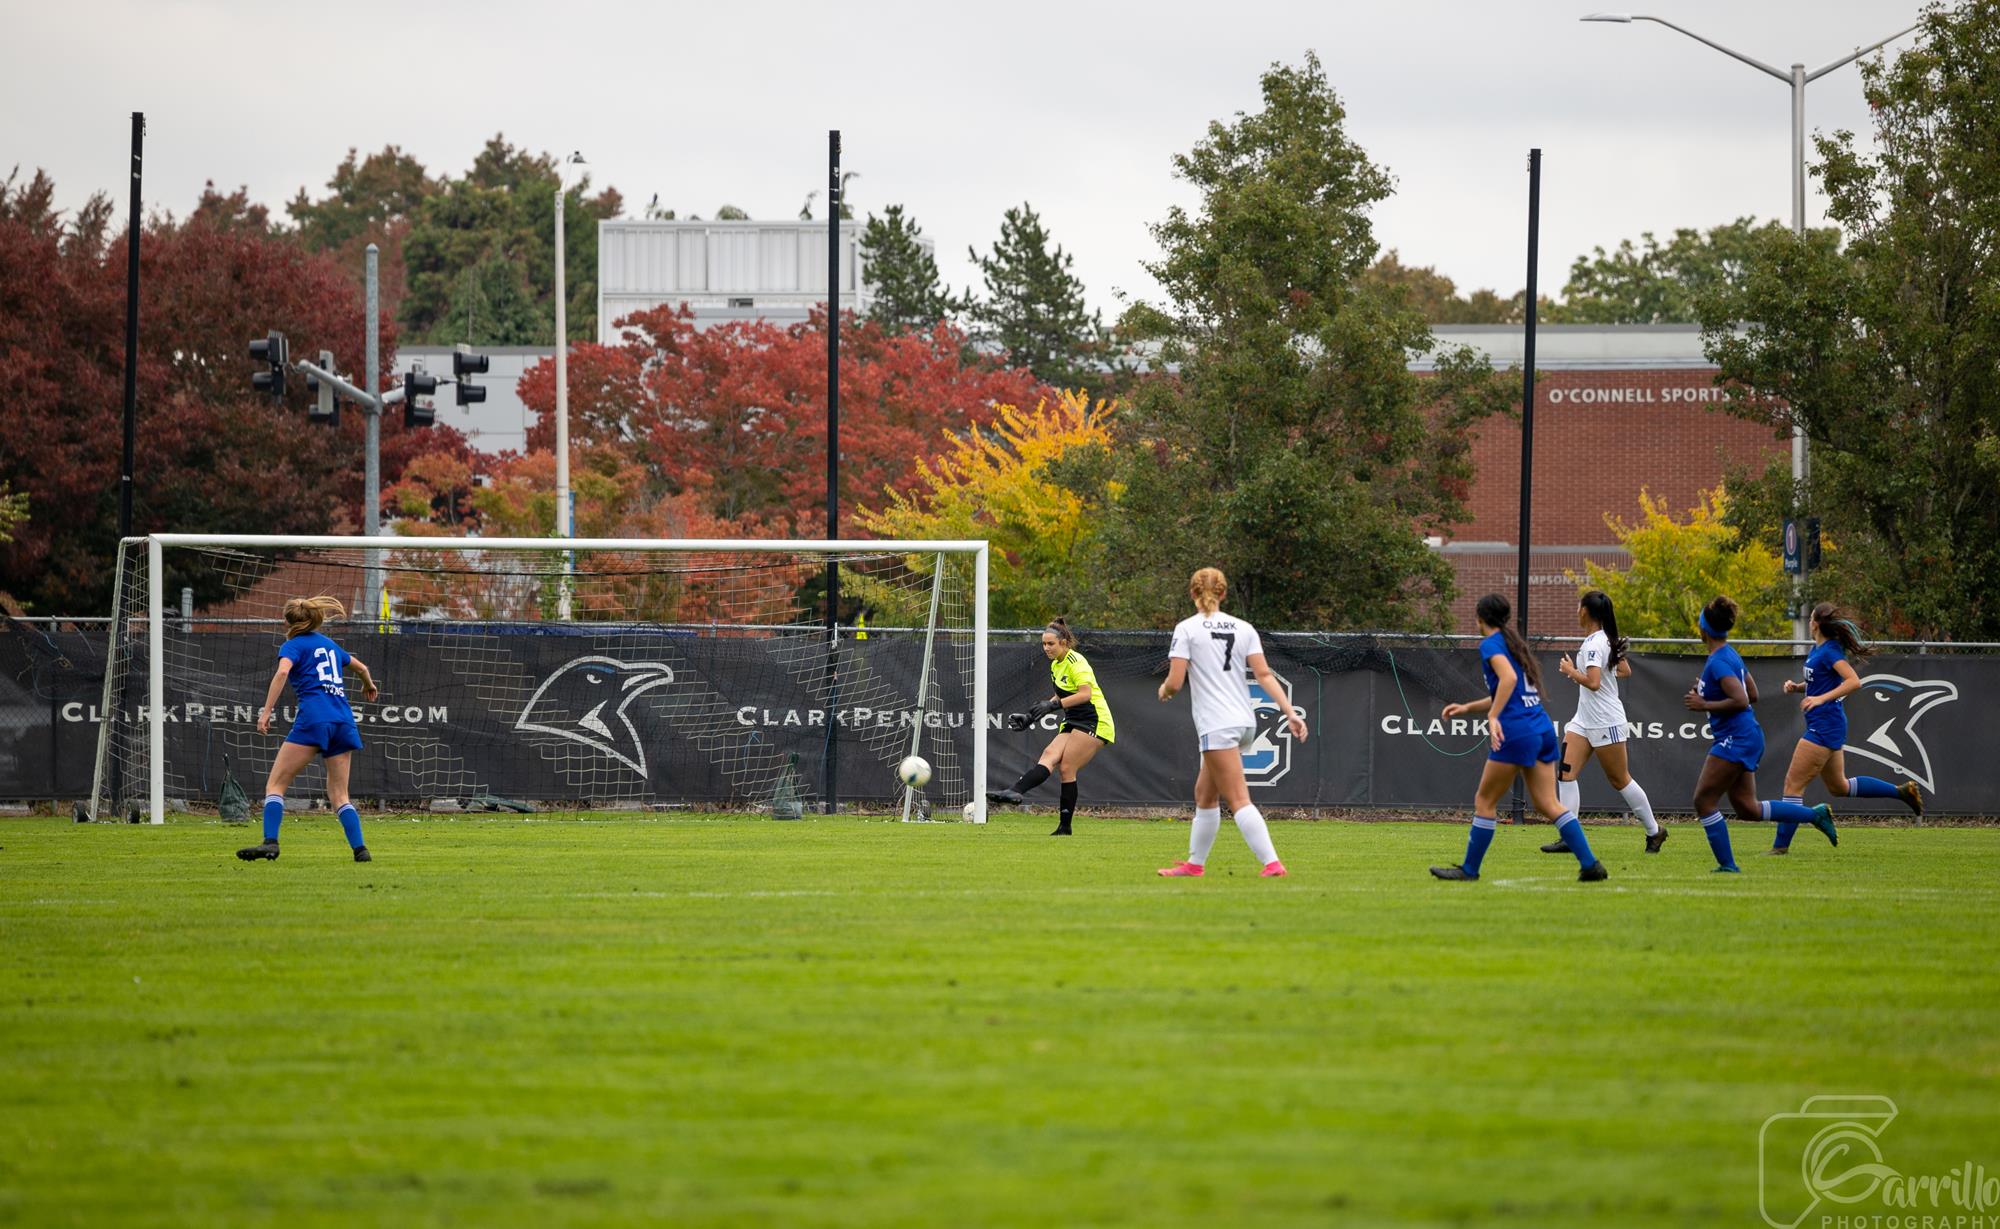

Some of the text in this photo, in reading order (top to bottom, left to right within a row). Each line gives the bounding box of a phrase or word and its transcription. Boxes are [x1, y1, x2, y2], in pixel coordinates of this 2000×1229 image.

[1549, 388, 1655, 403] O'CONNELL
[1504, 575, 1569, 585] THMPSON
[1202, 620, 1238, 630] CLARK
[1210, 632, 1235, 671] 7
[313, 647, 343, 684] 21
